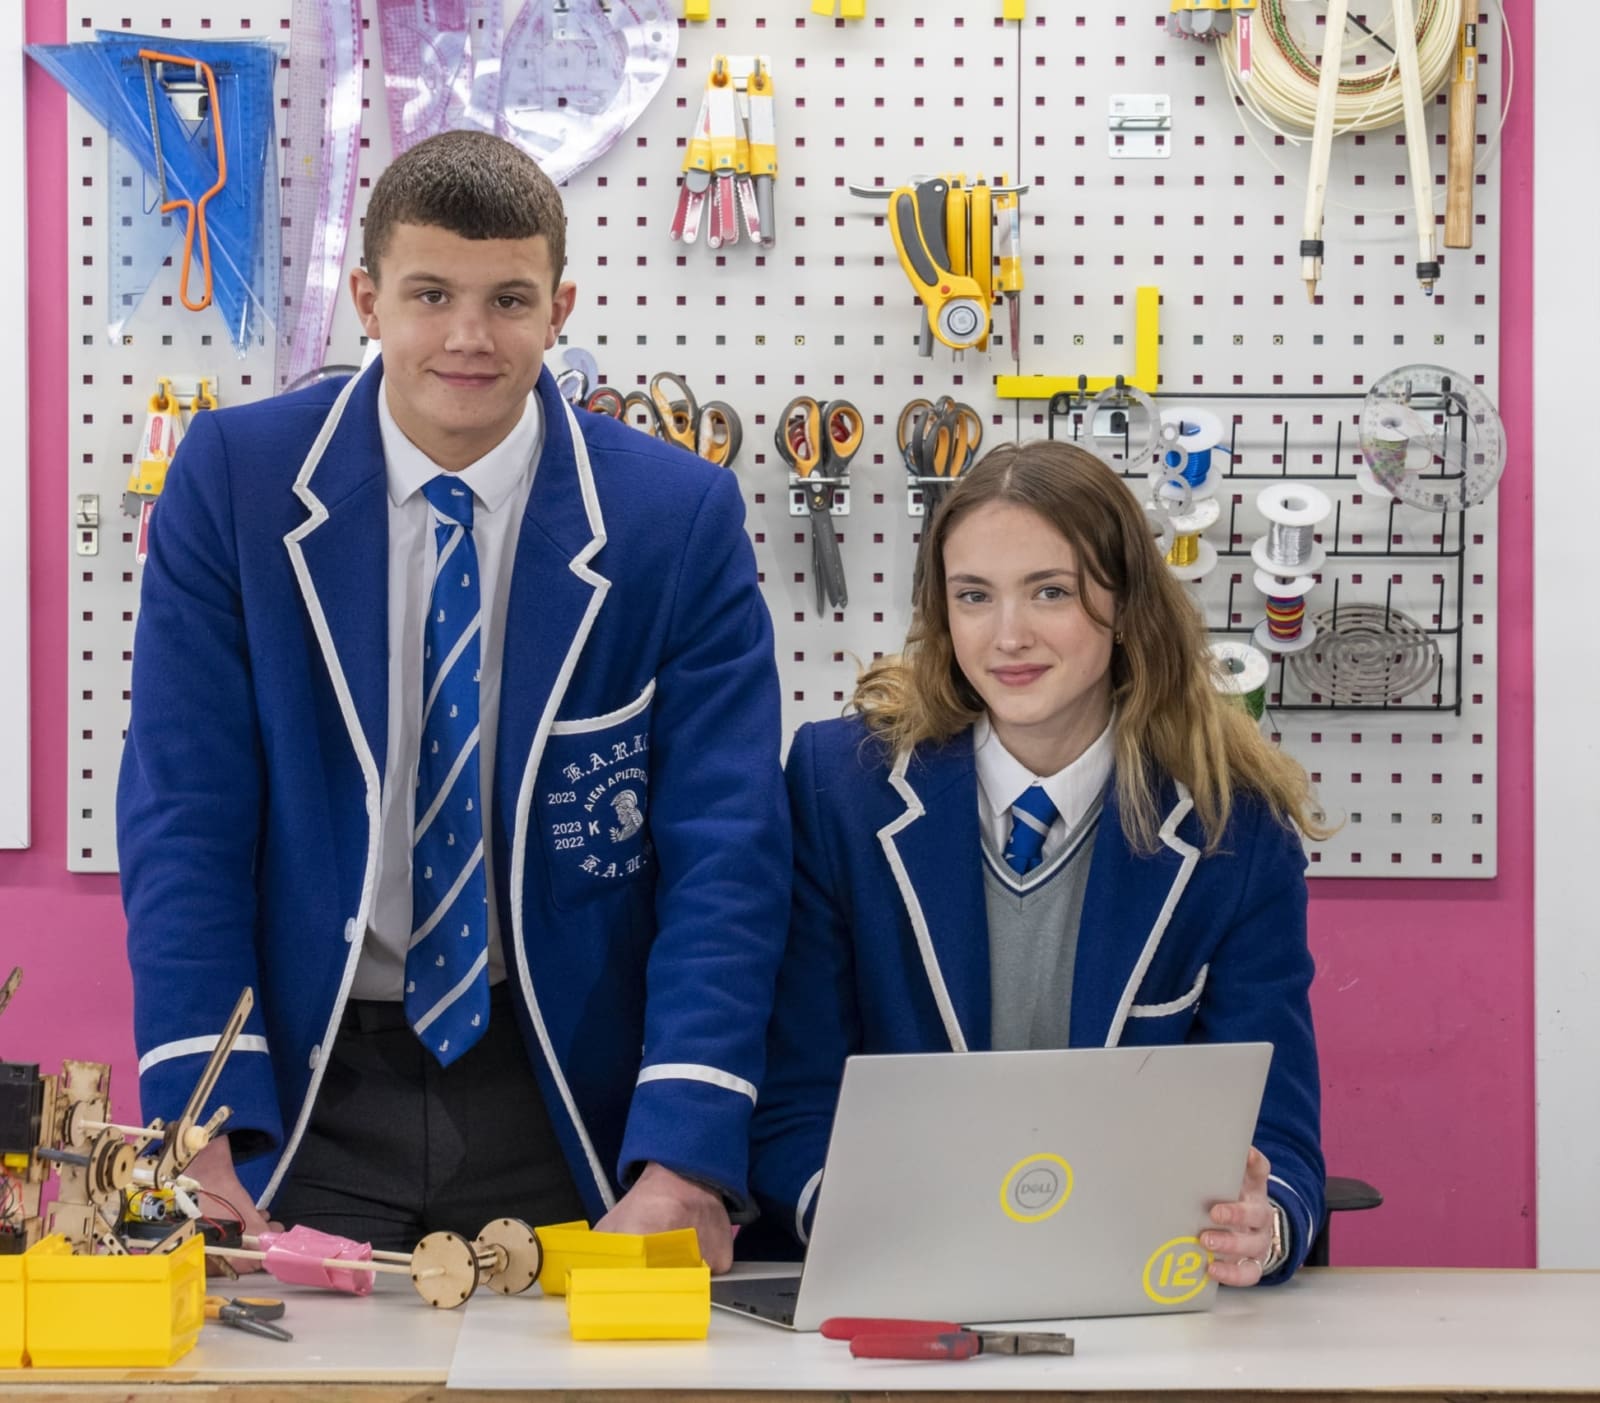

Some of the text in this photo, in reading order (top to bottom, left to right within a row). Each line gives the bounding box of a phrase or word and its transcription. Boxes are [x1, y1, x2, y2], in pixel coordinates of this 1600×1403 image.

[548, 791, 577, 805] 2023
[552, 821, 582, 835] 2023
[588, 820, 601, 836] K
[554, 836, 585, 850] 2022
[1020, 1182, 1053, 1195] DELL
[1158, 1251, 1202, 1288] 12
